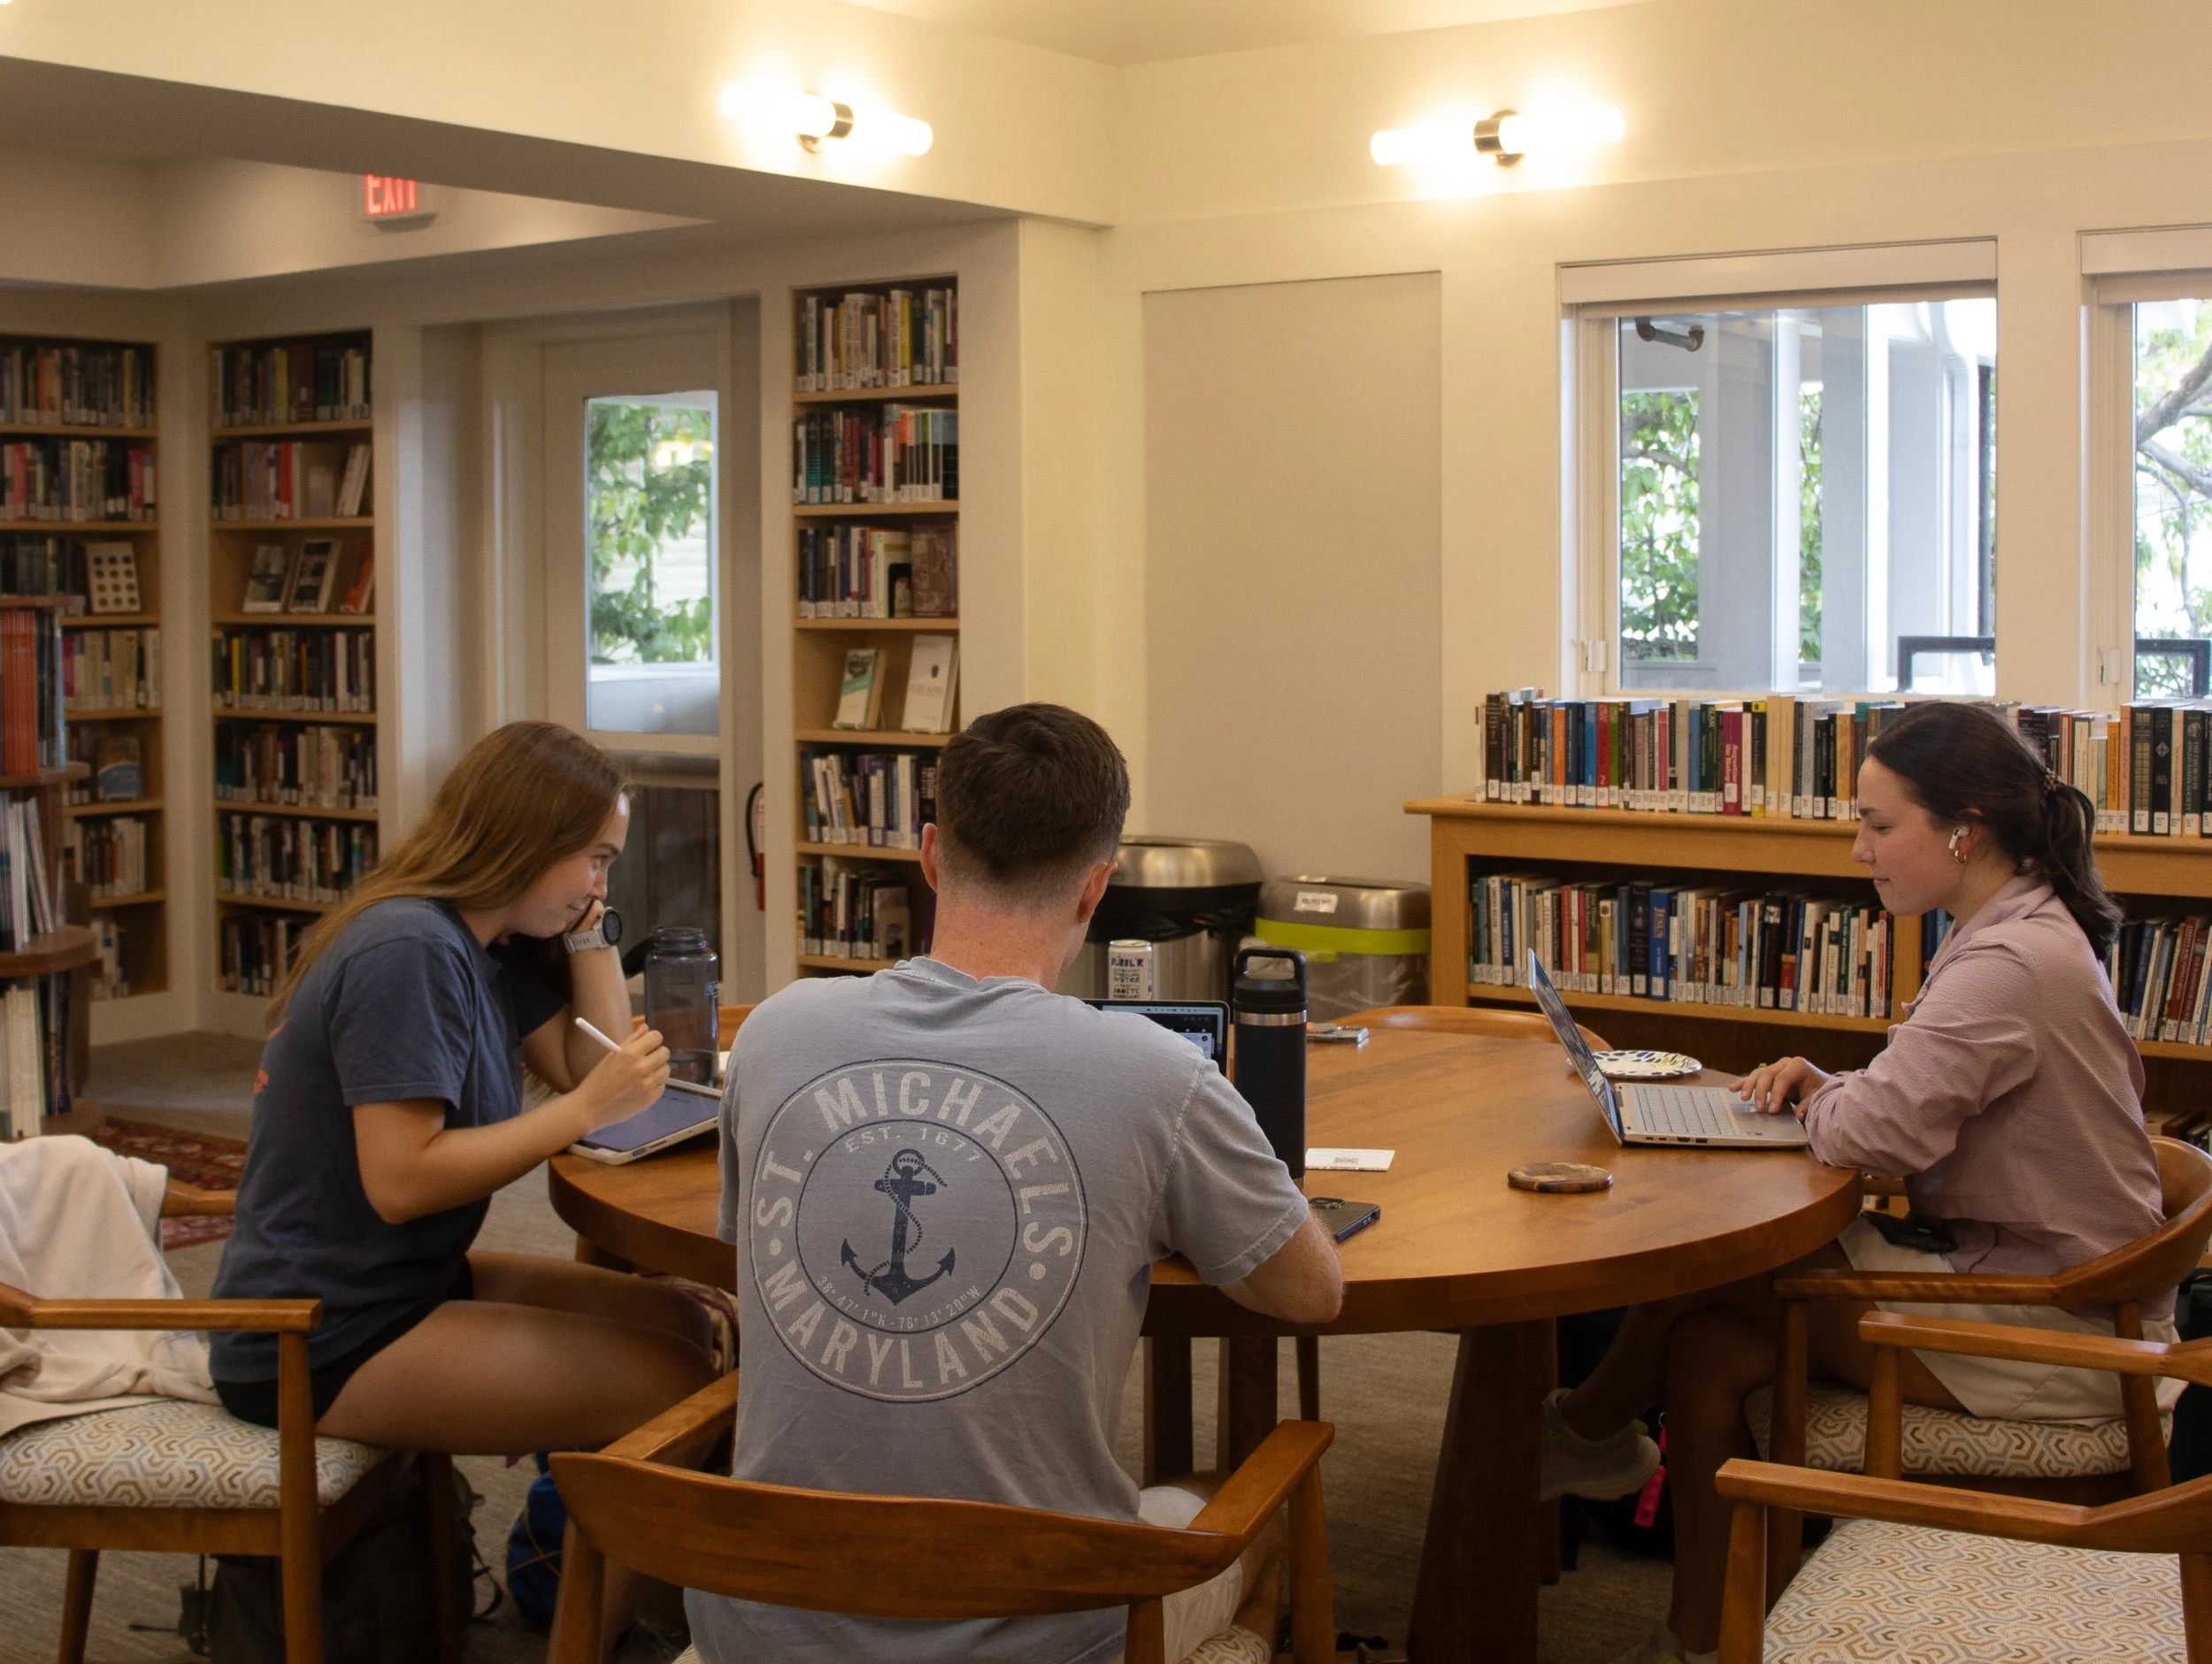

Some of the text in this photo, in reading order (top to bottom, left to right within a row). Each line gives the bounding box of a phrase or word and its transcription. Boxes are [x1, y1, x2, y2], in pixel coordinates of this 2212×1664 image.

[1600, 775, 1606, 785] 2
[757, 1070, 1073, 1257] ST. MICHAELS
[843, 1126, 901, 1153] EST.
[764, 1259, 1039, 1389] MARYLAND
